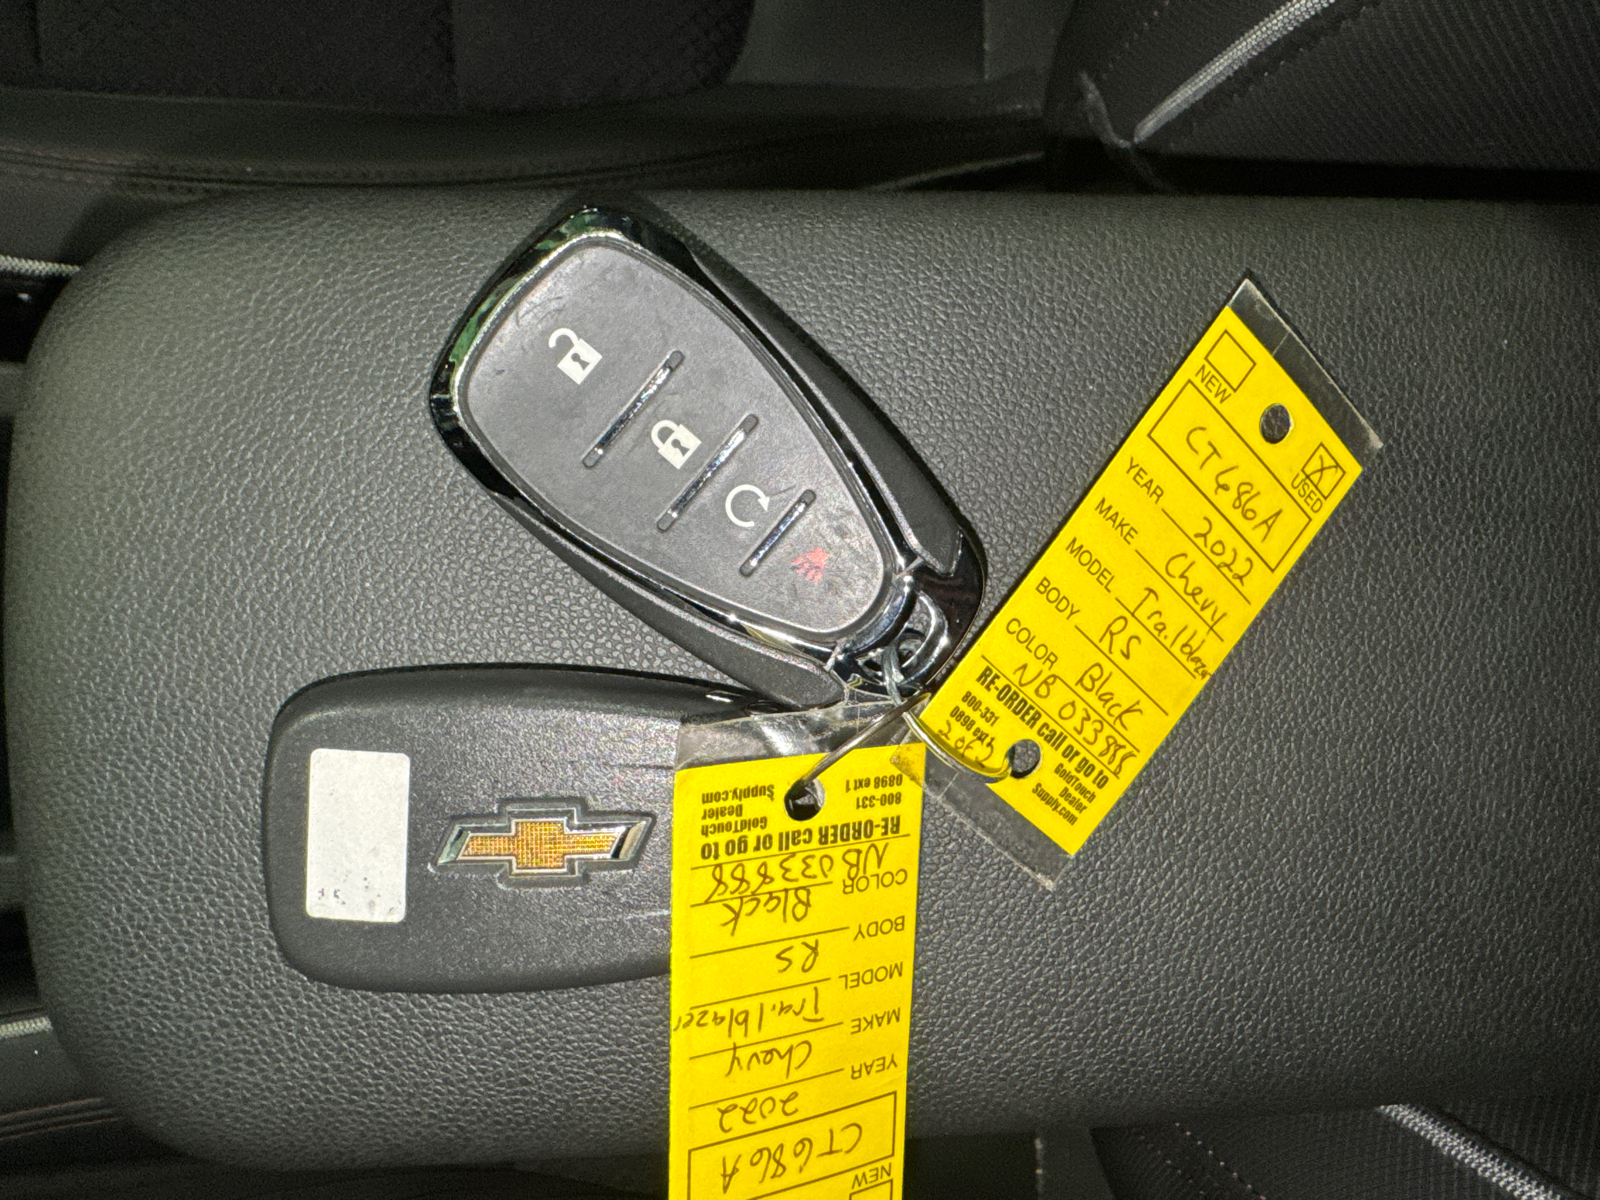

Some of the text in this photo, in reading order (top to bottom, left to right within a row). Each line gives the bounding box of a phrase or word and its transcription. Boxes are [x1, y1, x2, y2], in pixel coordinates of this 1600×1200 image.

[1195, 364, 1231, 404] NEW
[1126, 457, 1164, 504] YEAR
[1186, 427, 1282, 542] CT686A
[1291, 473, 1323, 514] USED
[1095, 497, 1138, 545] MAKE
[1066, 537, 1117, 593] MODEL
[1194, 516, 1253, 587] 2022
[1035, 576, 1080, 620] BODY
[1165, 553, 1227, 636] Chevy
[1005, 617, 1058, 671] COLOR
[1099, 616, 1141, 660] RS
[1013, 663, 1058, 699] NB
[1075, 662, 1143, 731] Black
[950, 706, 974, 730] 0898
[972, 726, 989, 743] ext
[961, 690, 1000, 727] 800-331
[976, 665, 1109, 790] RE-ORDER call or go to
[701, 784, 774, 805] Supply.com
[845, 773, 903, 793] 0898 ext 1
[856, 792, 902, 810] 800-331
[1053, 762, 1096, 803] GoldTouch
[1058, 786, 1087, 814] Dealer
[701, 804, 743, 820] Dealer
[1031, 782, 1078, 826] Supply.com
[701, 816, 767, 837] GoldTouch
[701, 815, 901, 861] RE-ORDER call or go to
[842, 868, 908, 895] COLOR
[721, 886, 812, 936] Black
[853, 915, 905, 941] BODY
[775, 939, 819, 973] RS
[838, 961, 903, 990] MODEL
[851, 1007, 900, 1034] MAKE
[725, 1040, 812, 1080] Chevy
[851, 1053, 898, 1080] YEAR
[717, 1091, 799, 1133] 2022
[720, 1122, 863, 1194] CT686A
[852, 1163, 892, 1189] NEW
